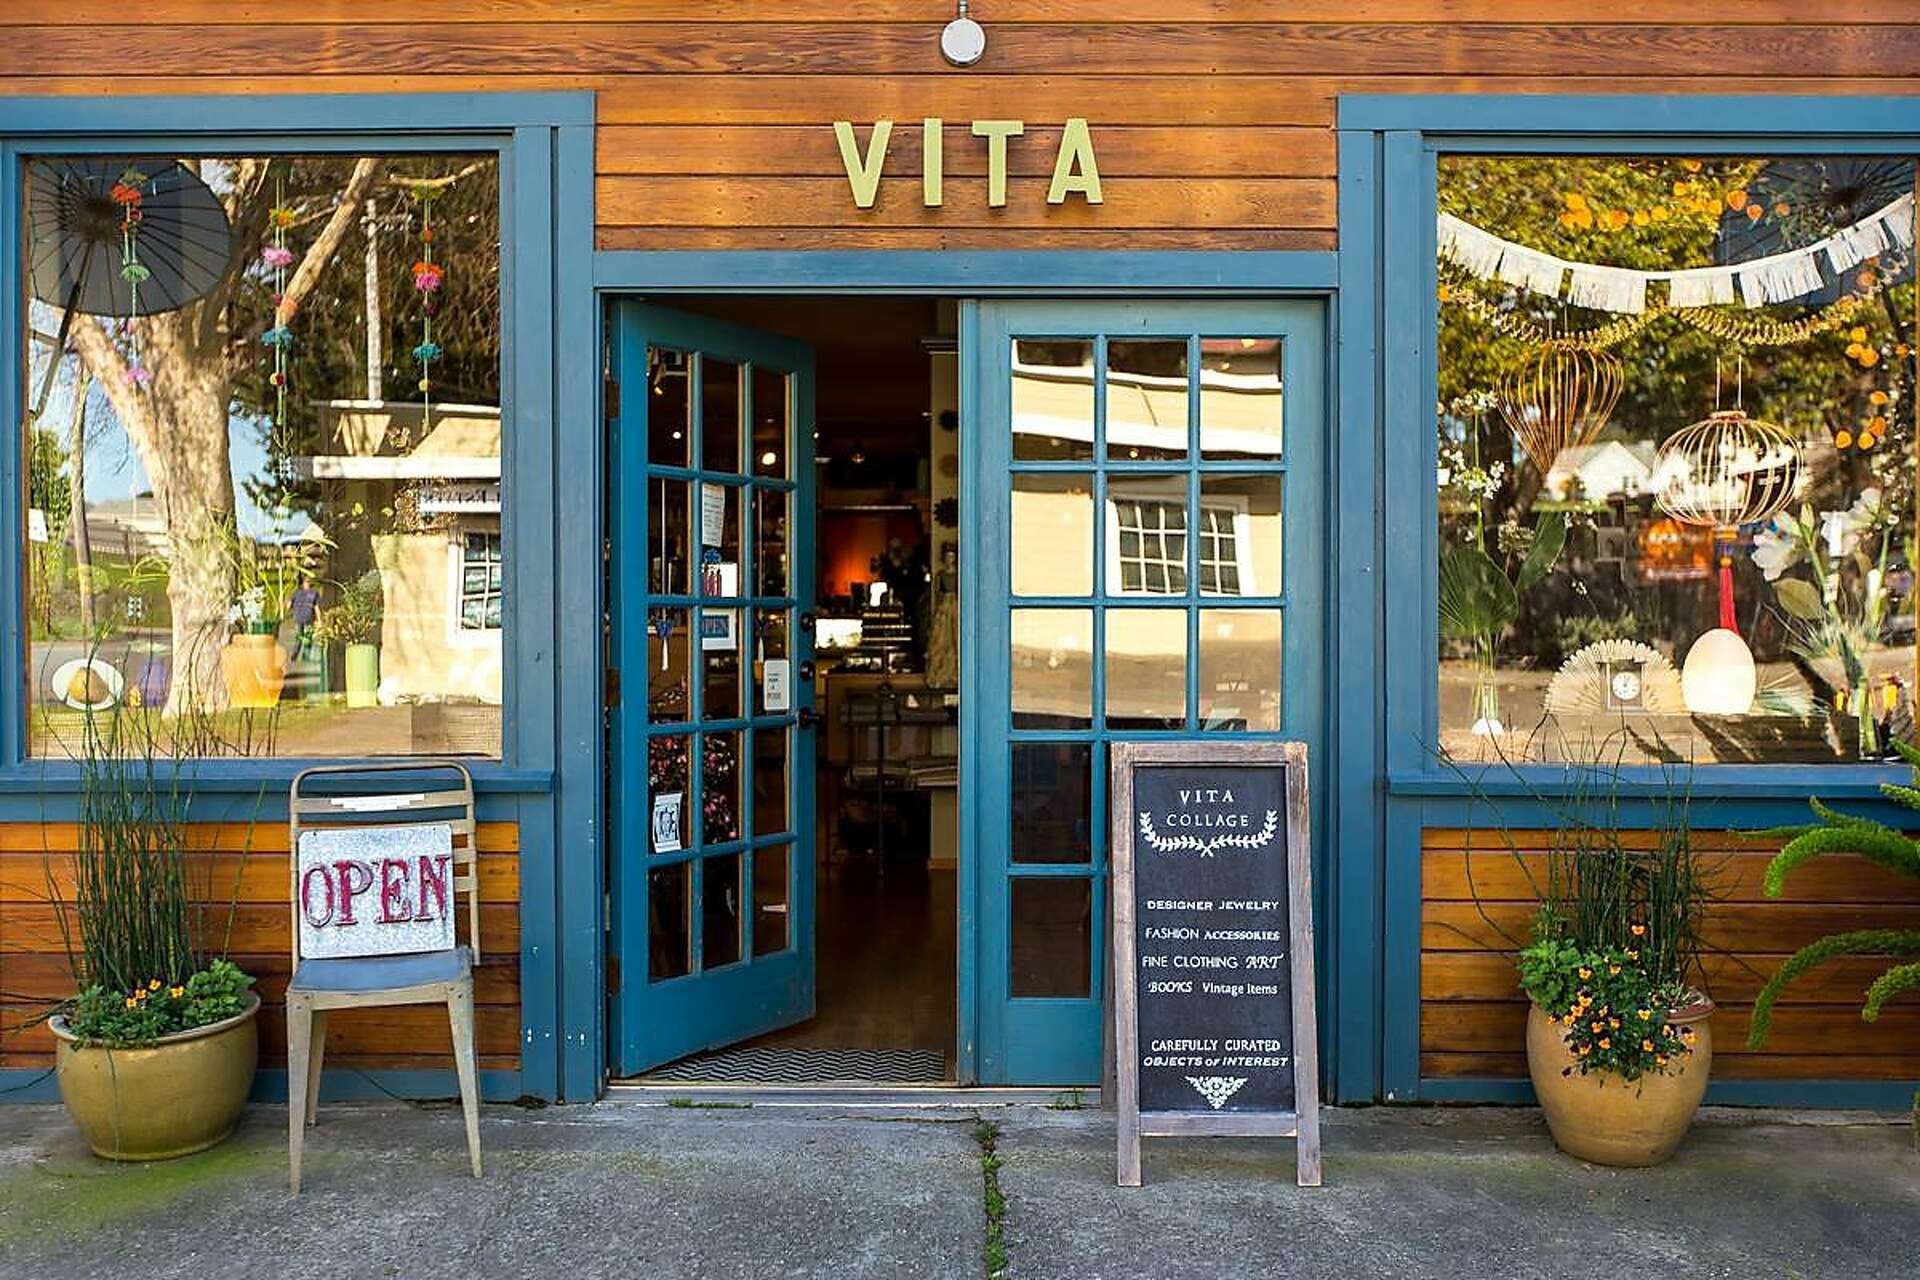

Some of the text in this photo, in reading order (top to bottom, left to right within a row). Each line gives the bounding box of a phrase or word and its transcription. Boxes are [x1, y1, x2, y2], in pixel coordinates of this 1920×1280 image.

[833, 118, 1103, 208] VITA
[1180, 790, 1234, 804] VITA
[1166, 813, 1249, 827] COLLAGE
[302, 855, 451, 928] OPEN
[1147, 900, 1279, 910] DESIGNER JEWELRY
[1145, 927, 1280, 941] FASHION ACCESSORIES
[1142, 953, 1284, 969] FINE CLOTHING ART
[1148, 981, 1193, 993] BOOKS
[1202, 982, 1244, 997] Vintage
[1151, 1040, 1281, 1052] CAREFULLY CURATED
[1143, 1057, 1203, 1067] OBJECTS
[1222, 1057, 1289, 1067] INTEREST
